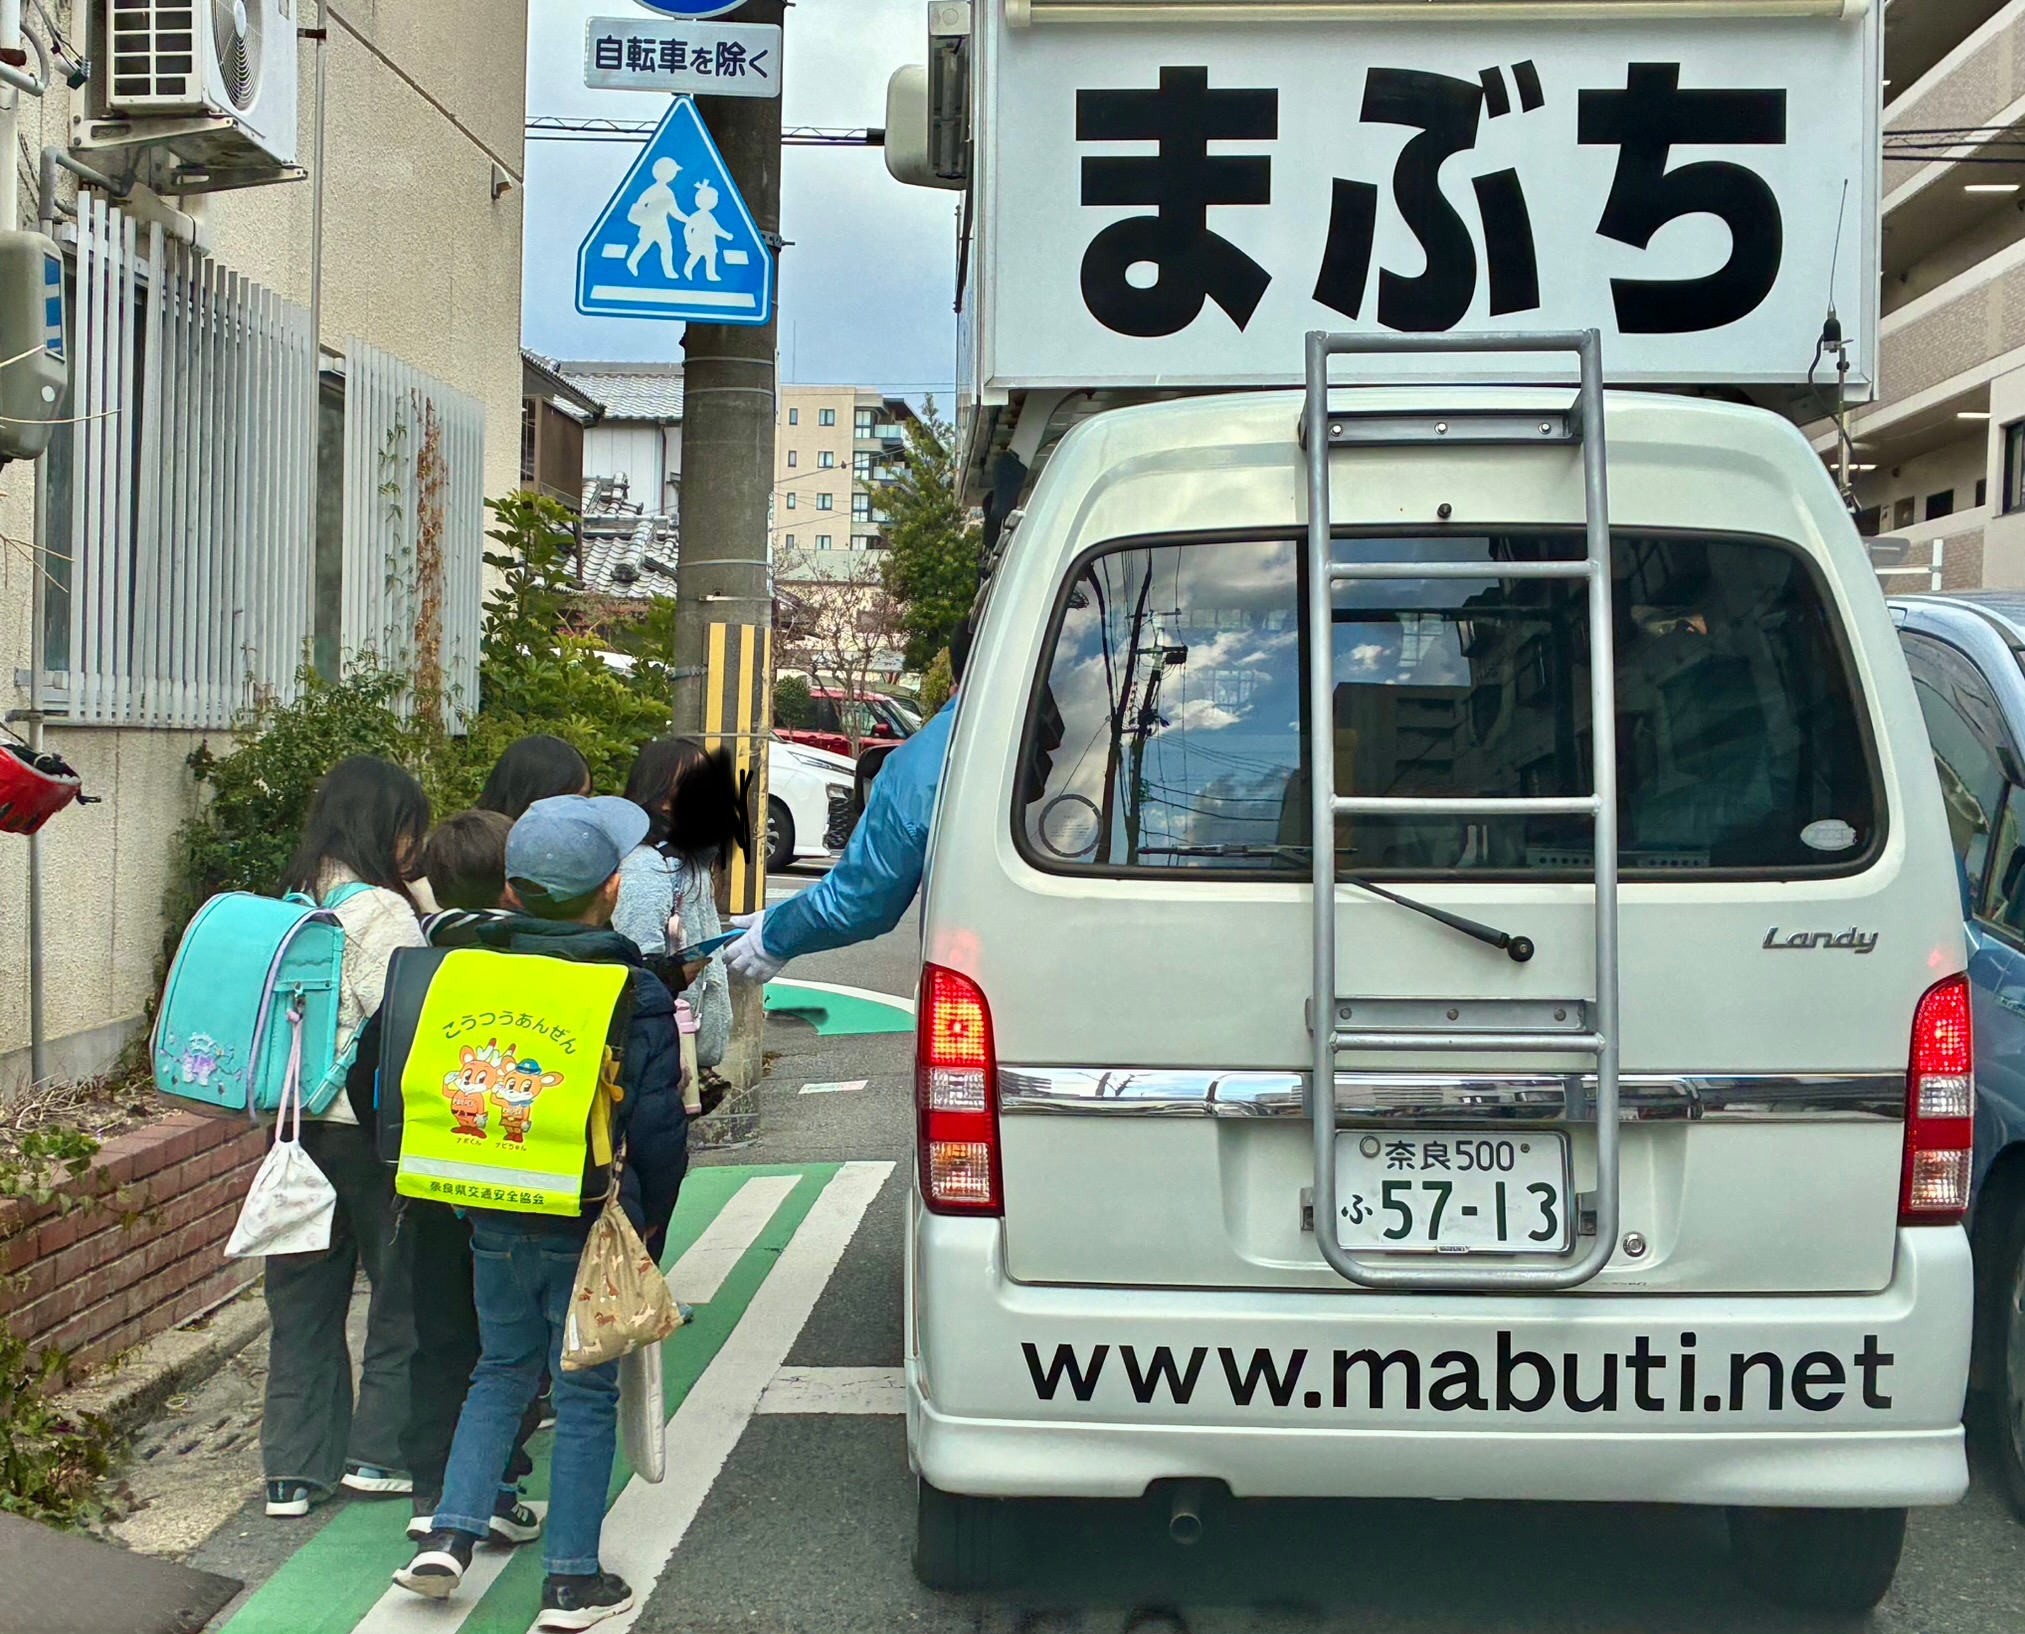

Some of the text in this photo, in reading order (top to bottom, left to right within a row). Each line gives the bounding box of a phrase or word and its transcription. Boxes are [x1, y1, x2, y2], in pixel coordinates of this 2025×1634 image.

[595, 34, 769, 79] 自転車を除く
[1075, 59, 1788, 337] まぶち
[1762, 926, 1879, 954] Landy
[442, 1010, 576, 1055] こうつうあんぜん
[1341, 1180, 1558, 1242] ふ 57-13
[1020, 1331, 1895, 1413] www.mabuti.net
